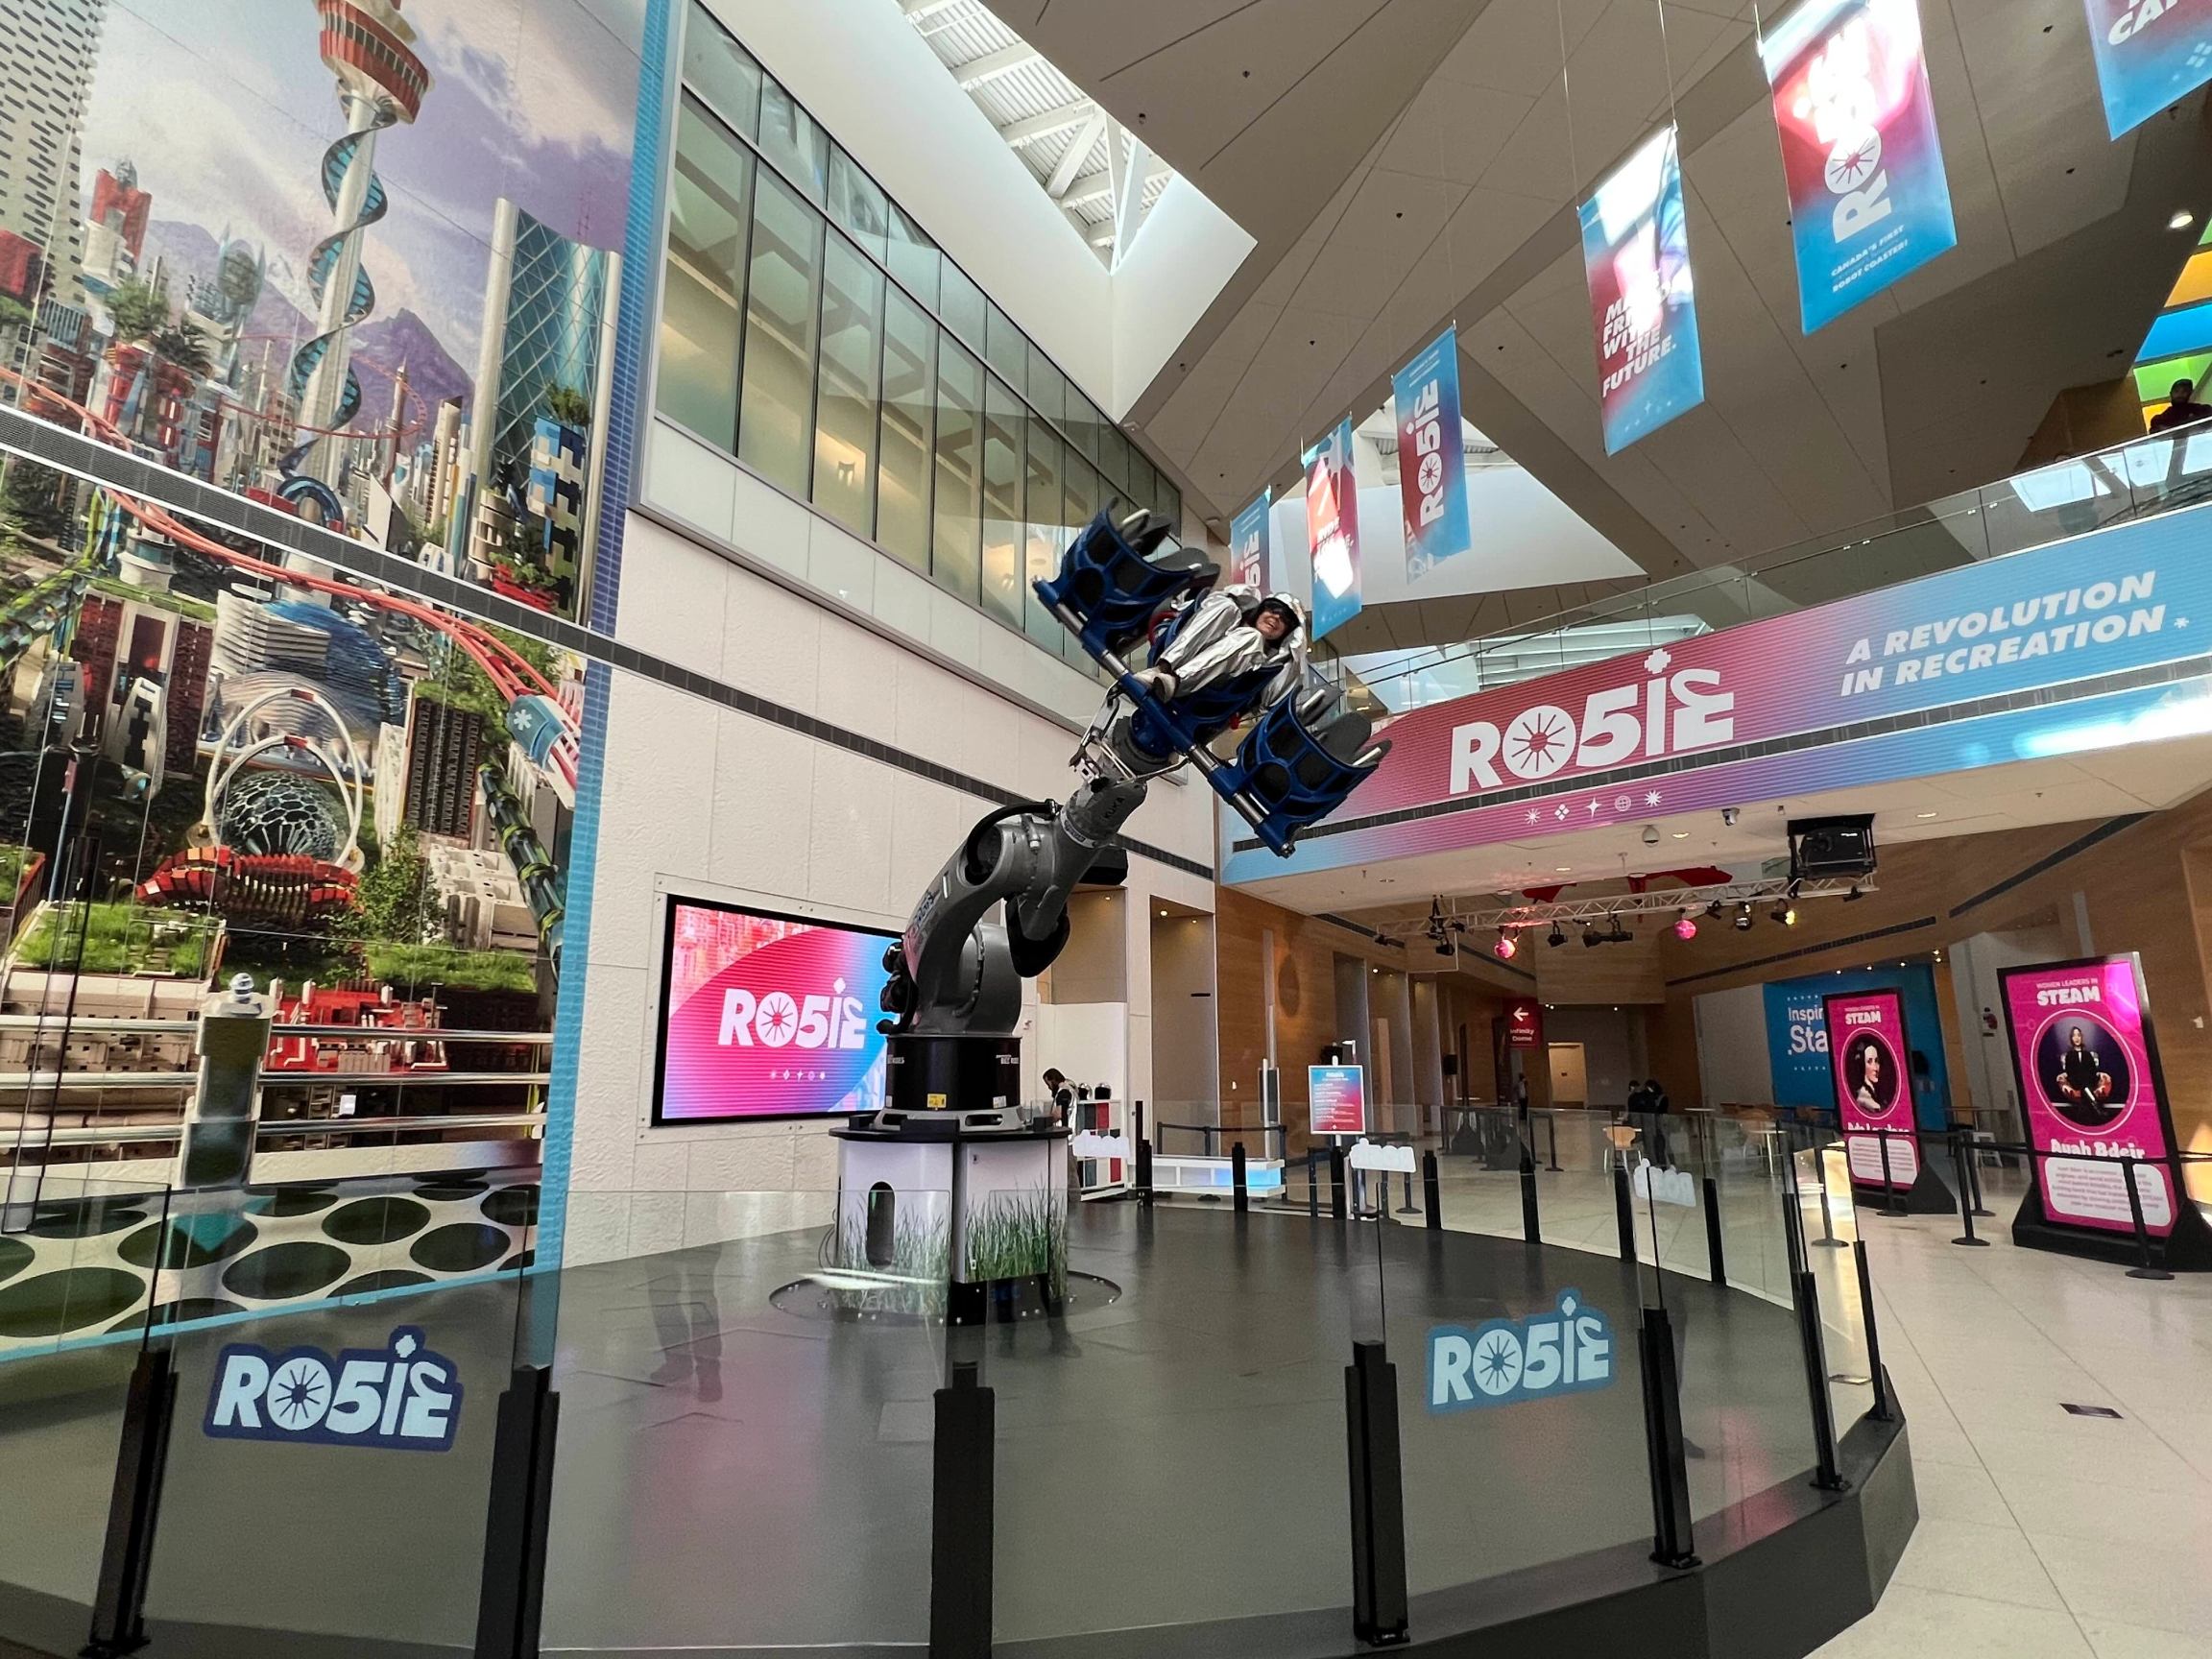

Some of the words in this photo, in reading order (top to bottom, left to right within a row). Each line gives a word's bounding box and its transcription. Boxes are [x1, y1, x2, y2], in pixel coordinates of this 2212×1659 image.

[1602, 334, 1677, 398] FUTURE.
[1845, 637, 1872, 665] A
[1883, 570, 2156, 657] REVOLUTION
[1840, 666, 1884, 697] IN
[1894, 604, 2166, 685] RECREATION
[1845, 1010, 1882, 1025] STEAM
[2036, 985, 2102, 1006] STEAM
